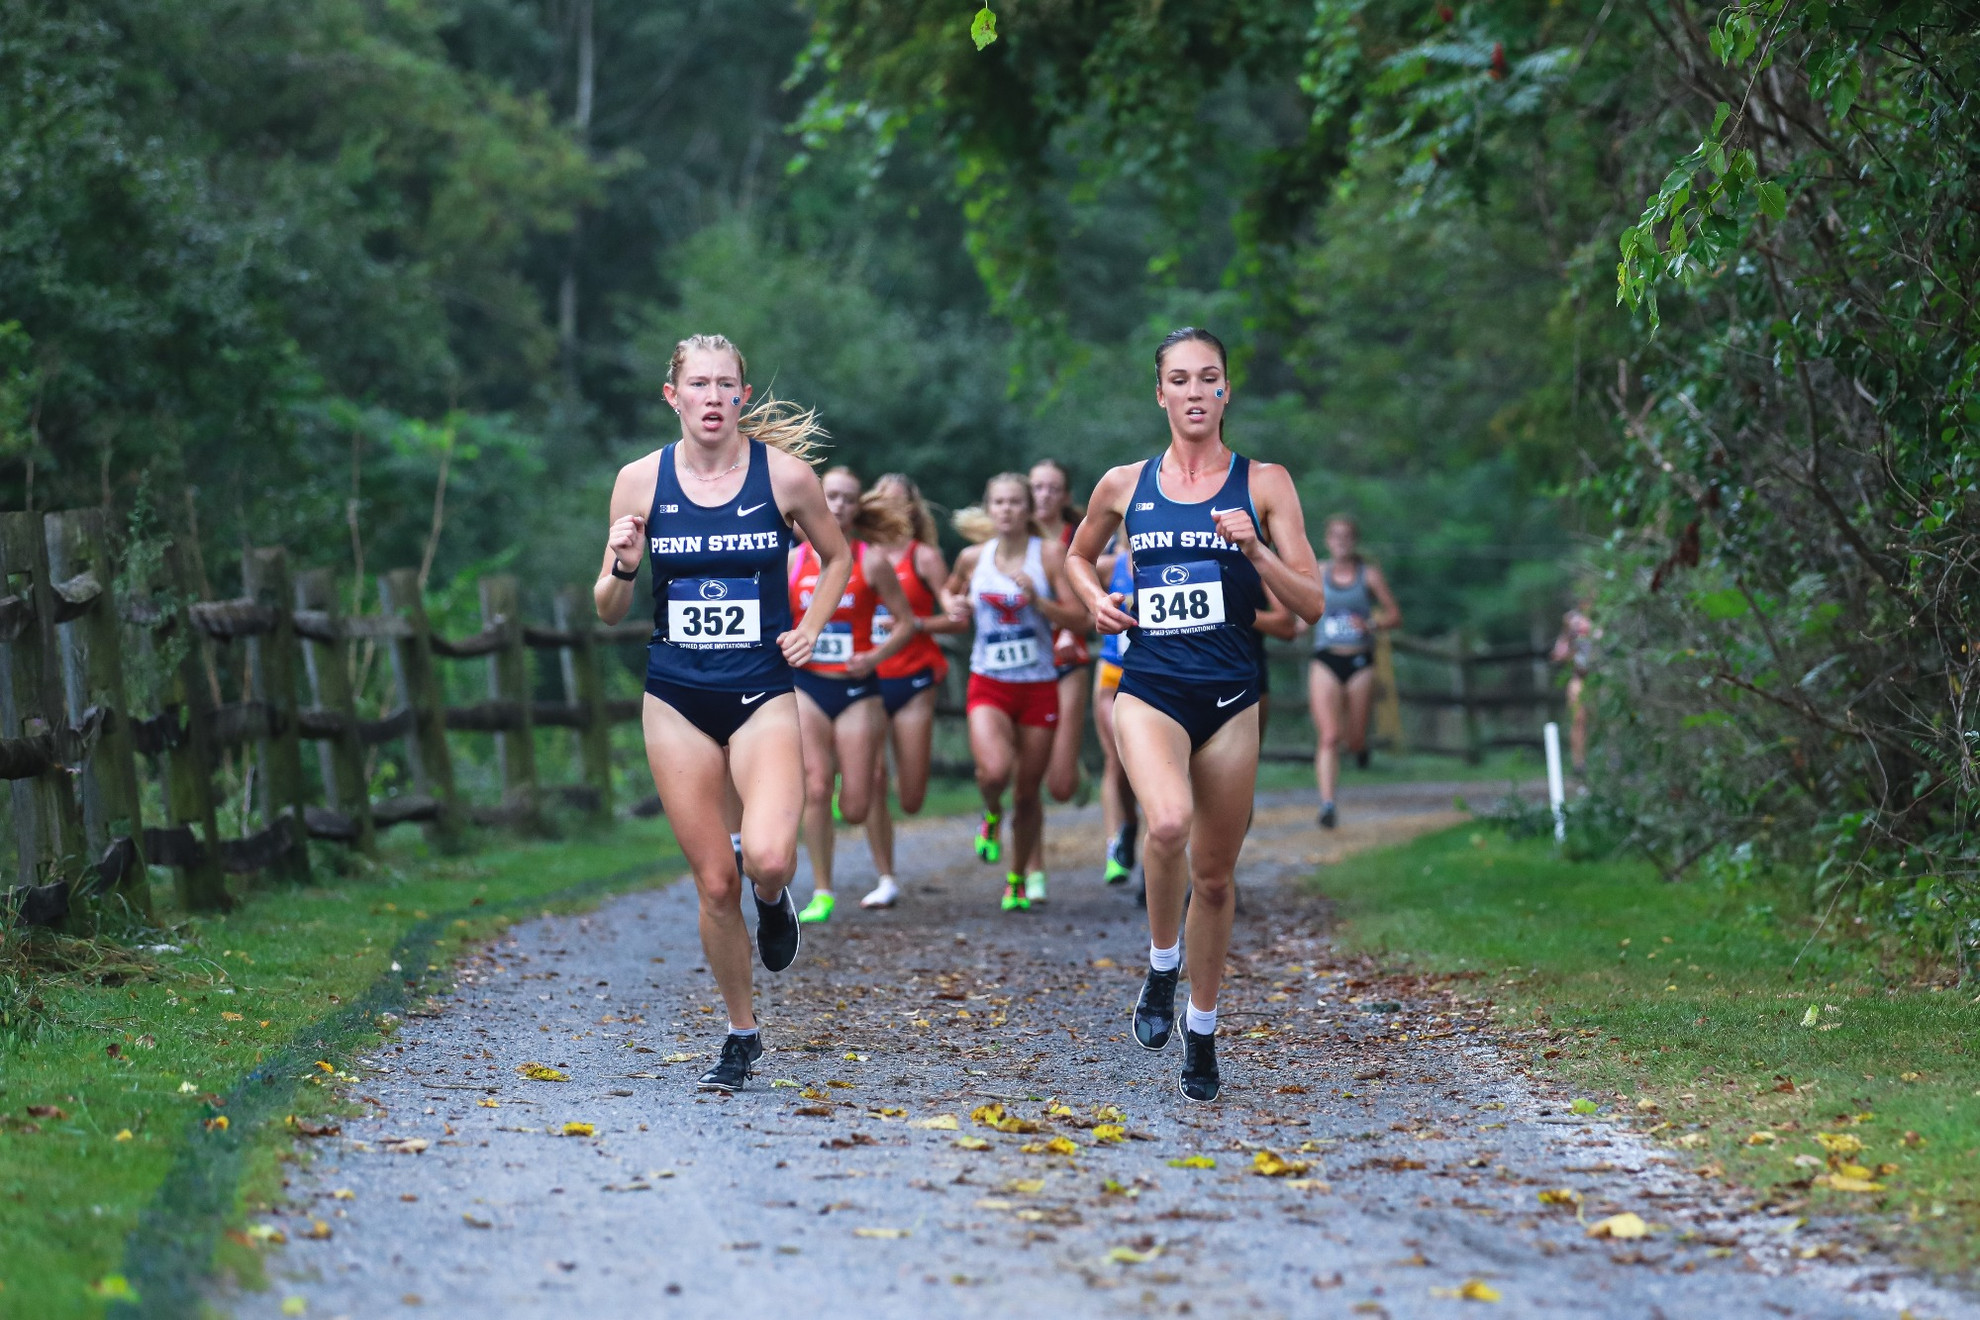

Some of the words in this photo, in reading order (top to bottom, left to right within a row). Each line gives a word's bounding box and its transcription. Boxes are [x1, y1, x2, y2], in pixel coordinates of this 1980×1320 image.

[651, 536, 702, 553] PENN
[708, 531, 778, 551] STATE
[682, 606, 745, 636] 352
[1150, 589, 1210, 623] 348
